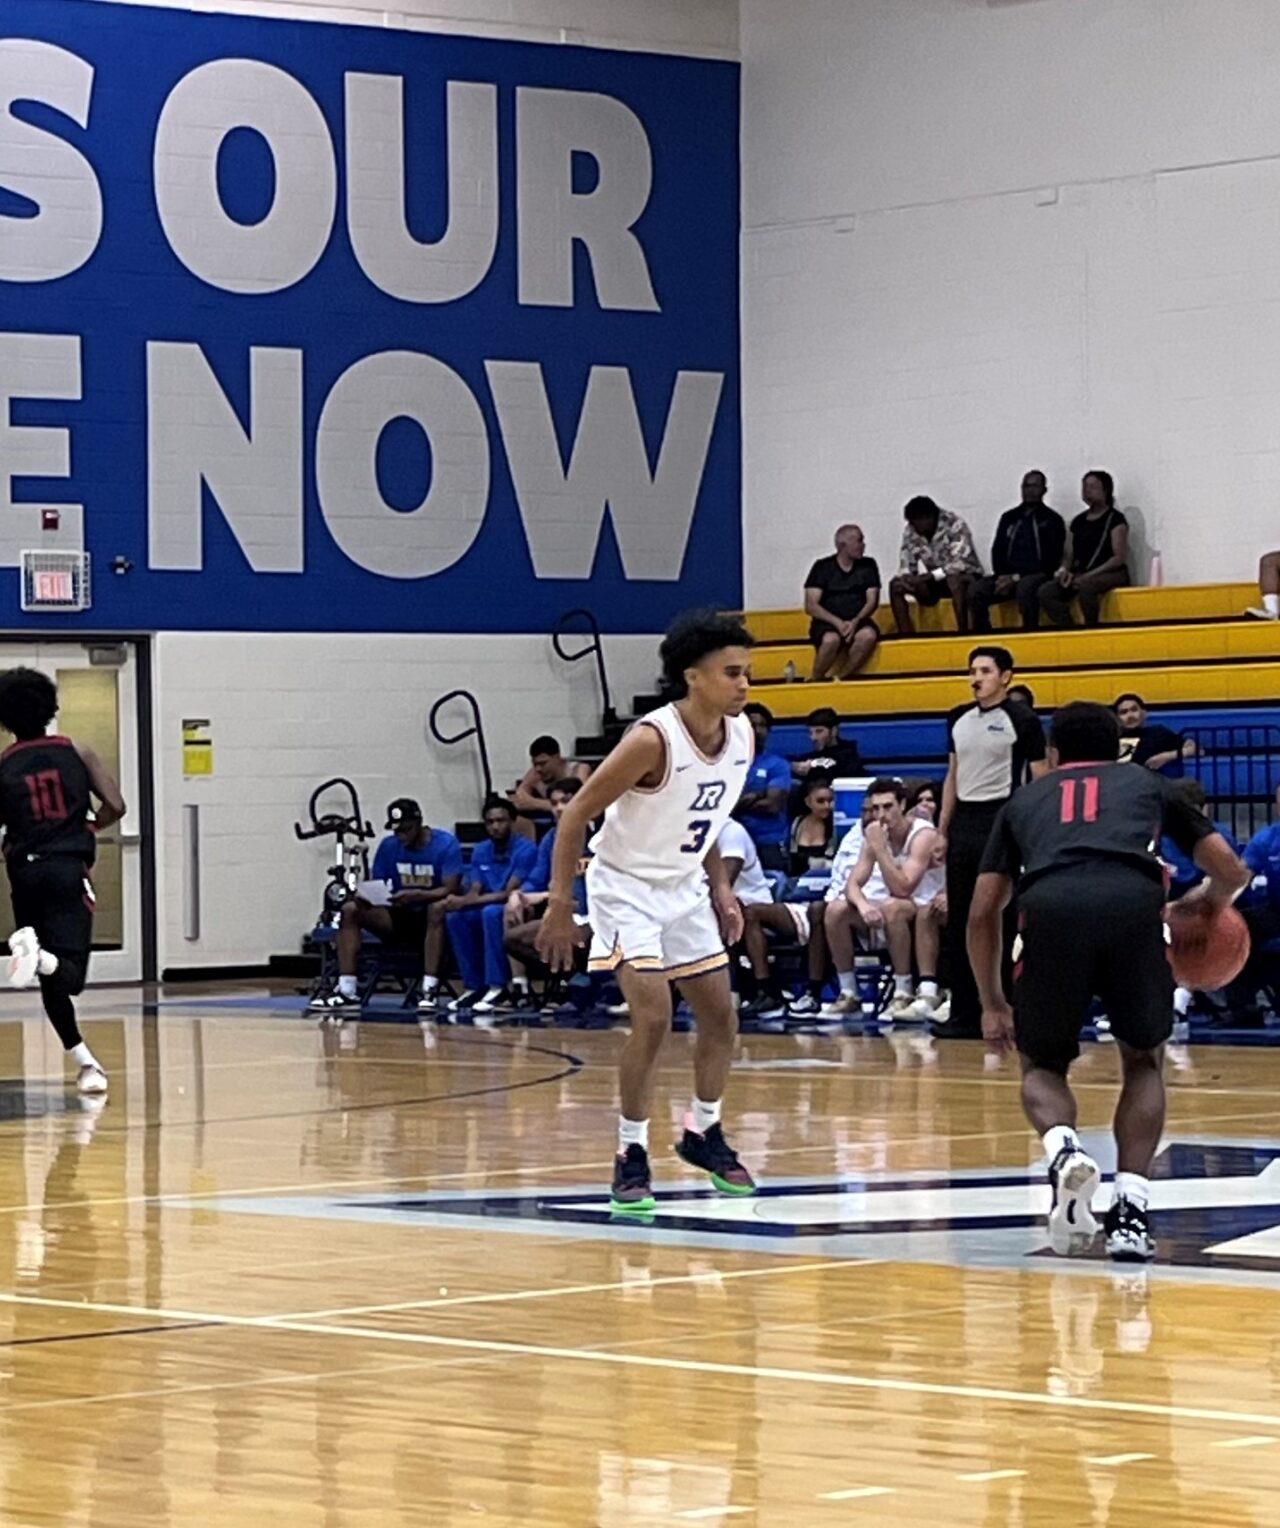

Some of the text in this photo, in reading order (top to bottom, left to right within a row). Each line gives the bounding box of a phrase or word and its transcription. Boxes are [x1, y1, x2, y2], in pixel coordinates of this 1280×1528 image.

[154, 58, 662, 312] OUR
[146, 340, 725, 582] NOW
[24, 769, 68, 820] 10
[1059, 777, 1098, 822] 11
[680, 819, 712, 853] 3
